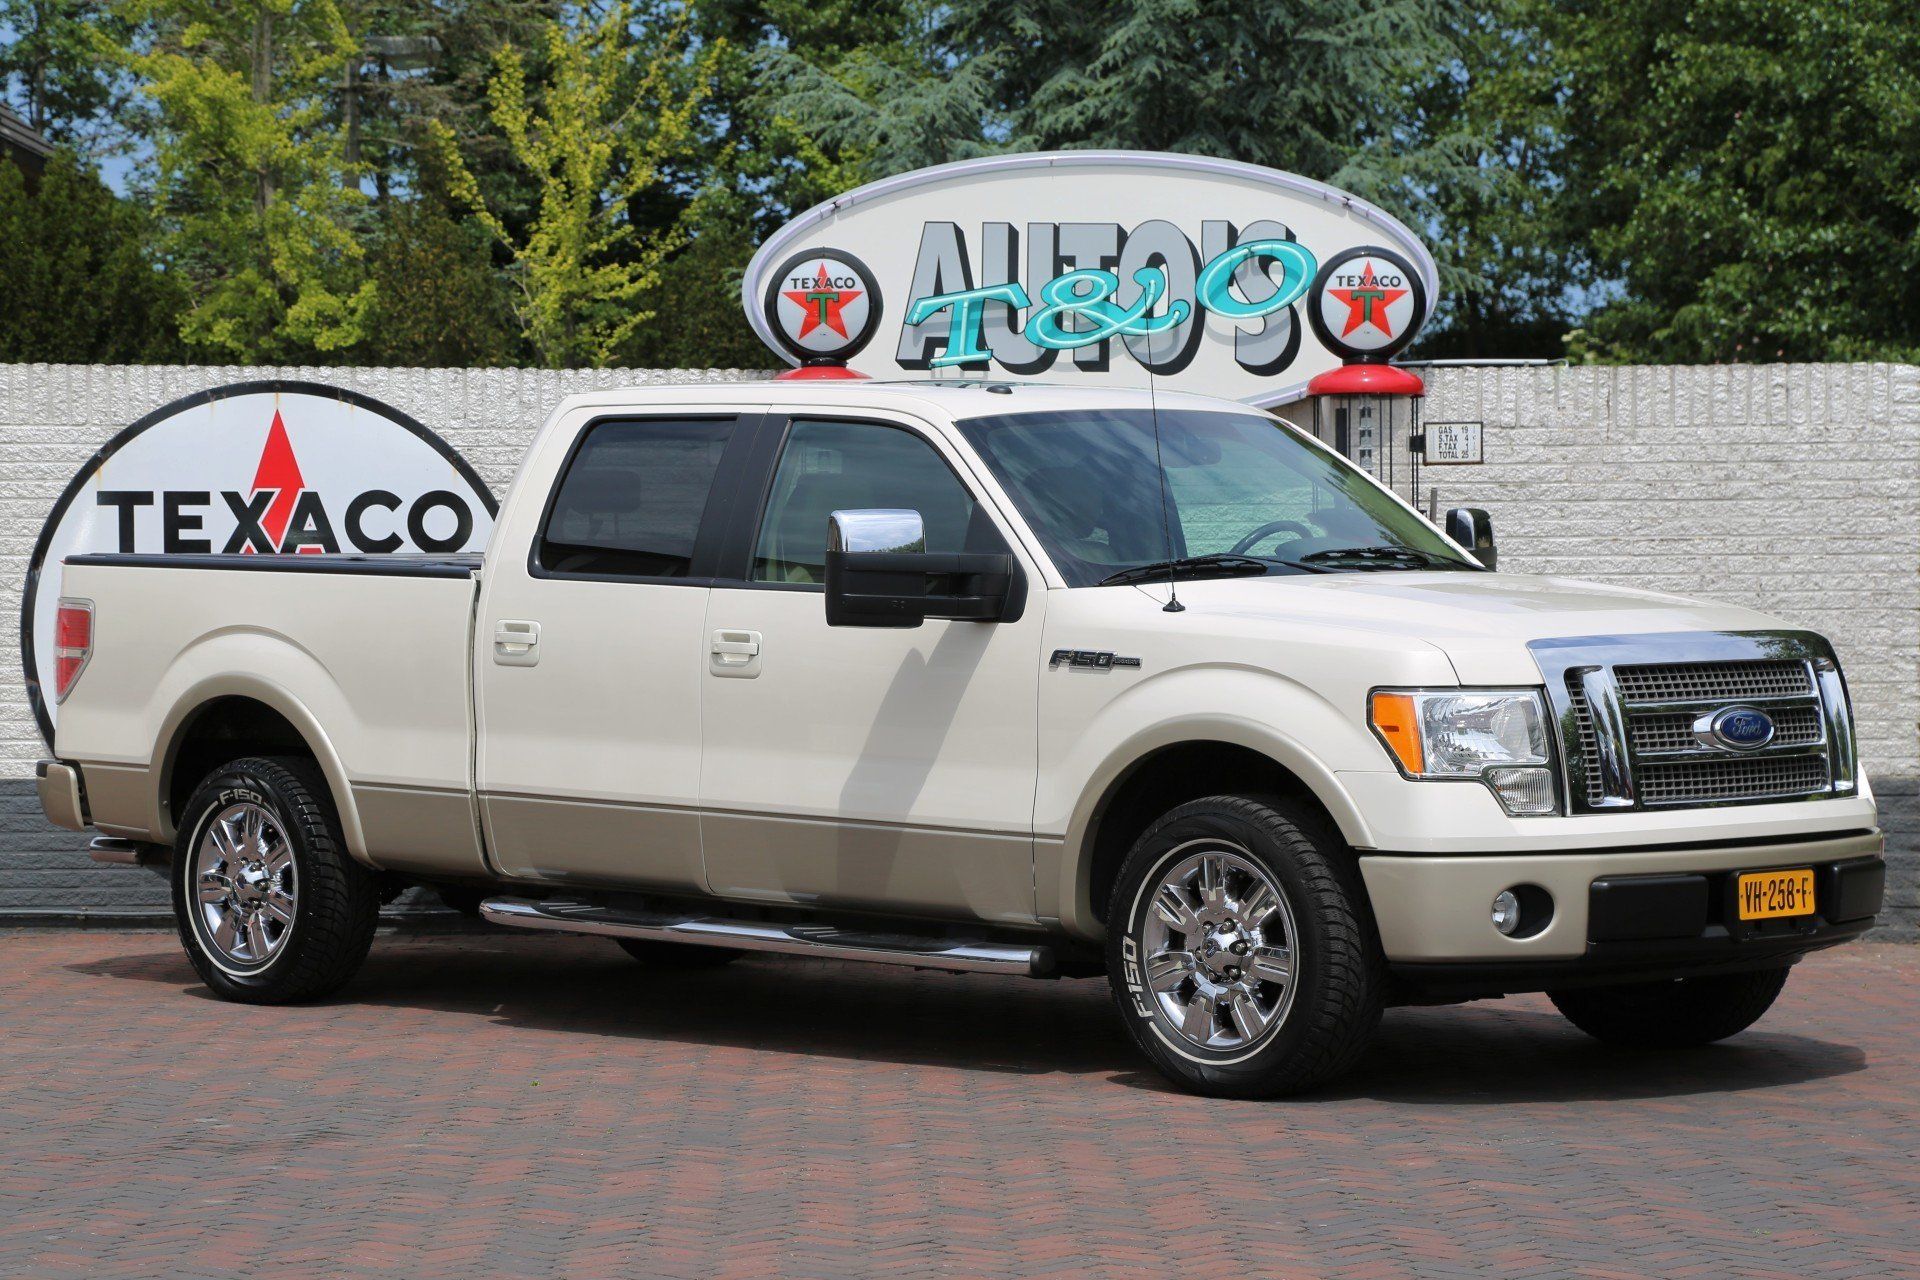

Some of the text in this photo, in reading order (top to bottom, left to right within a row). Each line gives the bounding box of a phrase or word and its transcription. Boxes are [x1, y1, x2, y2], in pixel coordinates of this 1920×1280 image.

[790, 277, 856, 290] TEXACO
[1336, 275, 1402, 288] TEXACO
[1438, 426, 1469, 434] GAS 19
[1438, 450, 1469, 459] TOTAL 25
[96, 490, 474, 554] TEXACO
[1732, 715, 1763, 738] Ford
[218, 788, 263, 805] F-150
[1744, 877, 1810, 914] VH-258-F
[1122, 935, 1155, 1018] F-150
